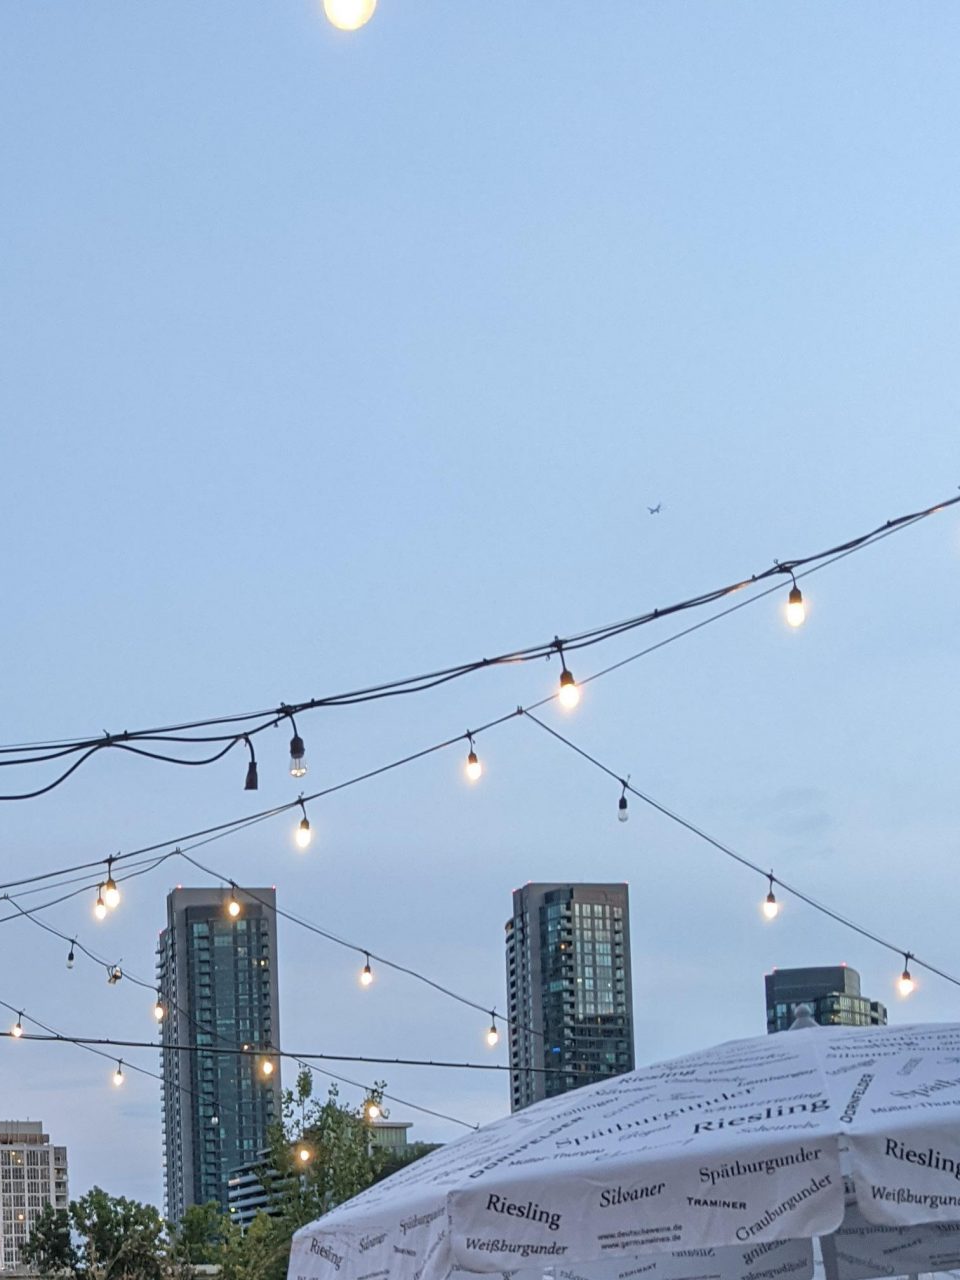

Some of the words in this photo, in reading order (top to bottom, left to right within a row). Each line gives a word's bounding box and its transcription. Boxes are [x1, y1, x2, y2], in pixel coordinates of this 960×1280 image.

[693, 1099, 832, 1135] Riesling
[840, 1073, 875, 1124] DORNFELDER
[699, 1147, 823, 1186] Spätburgunder
[486, 1193, 563, 1231] Riesling
[600, 1182, 666, 1208] Silvaner
[686, 1196, 747, 1211] TRAMINER
[736, 1173, 833, 1242] Grauburgunder
[465, 1236, 569, 1258] Weißburgunder
